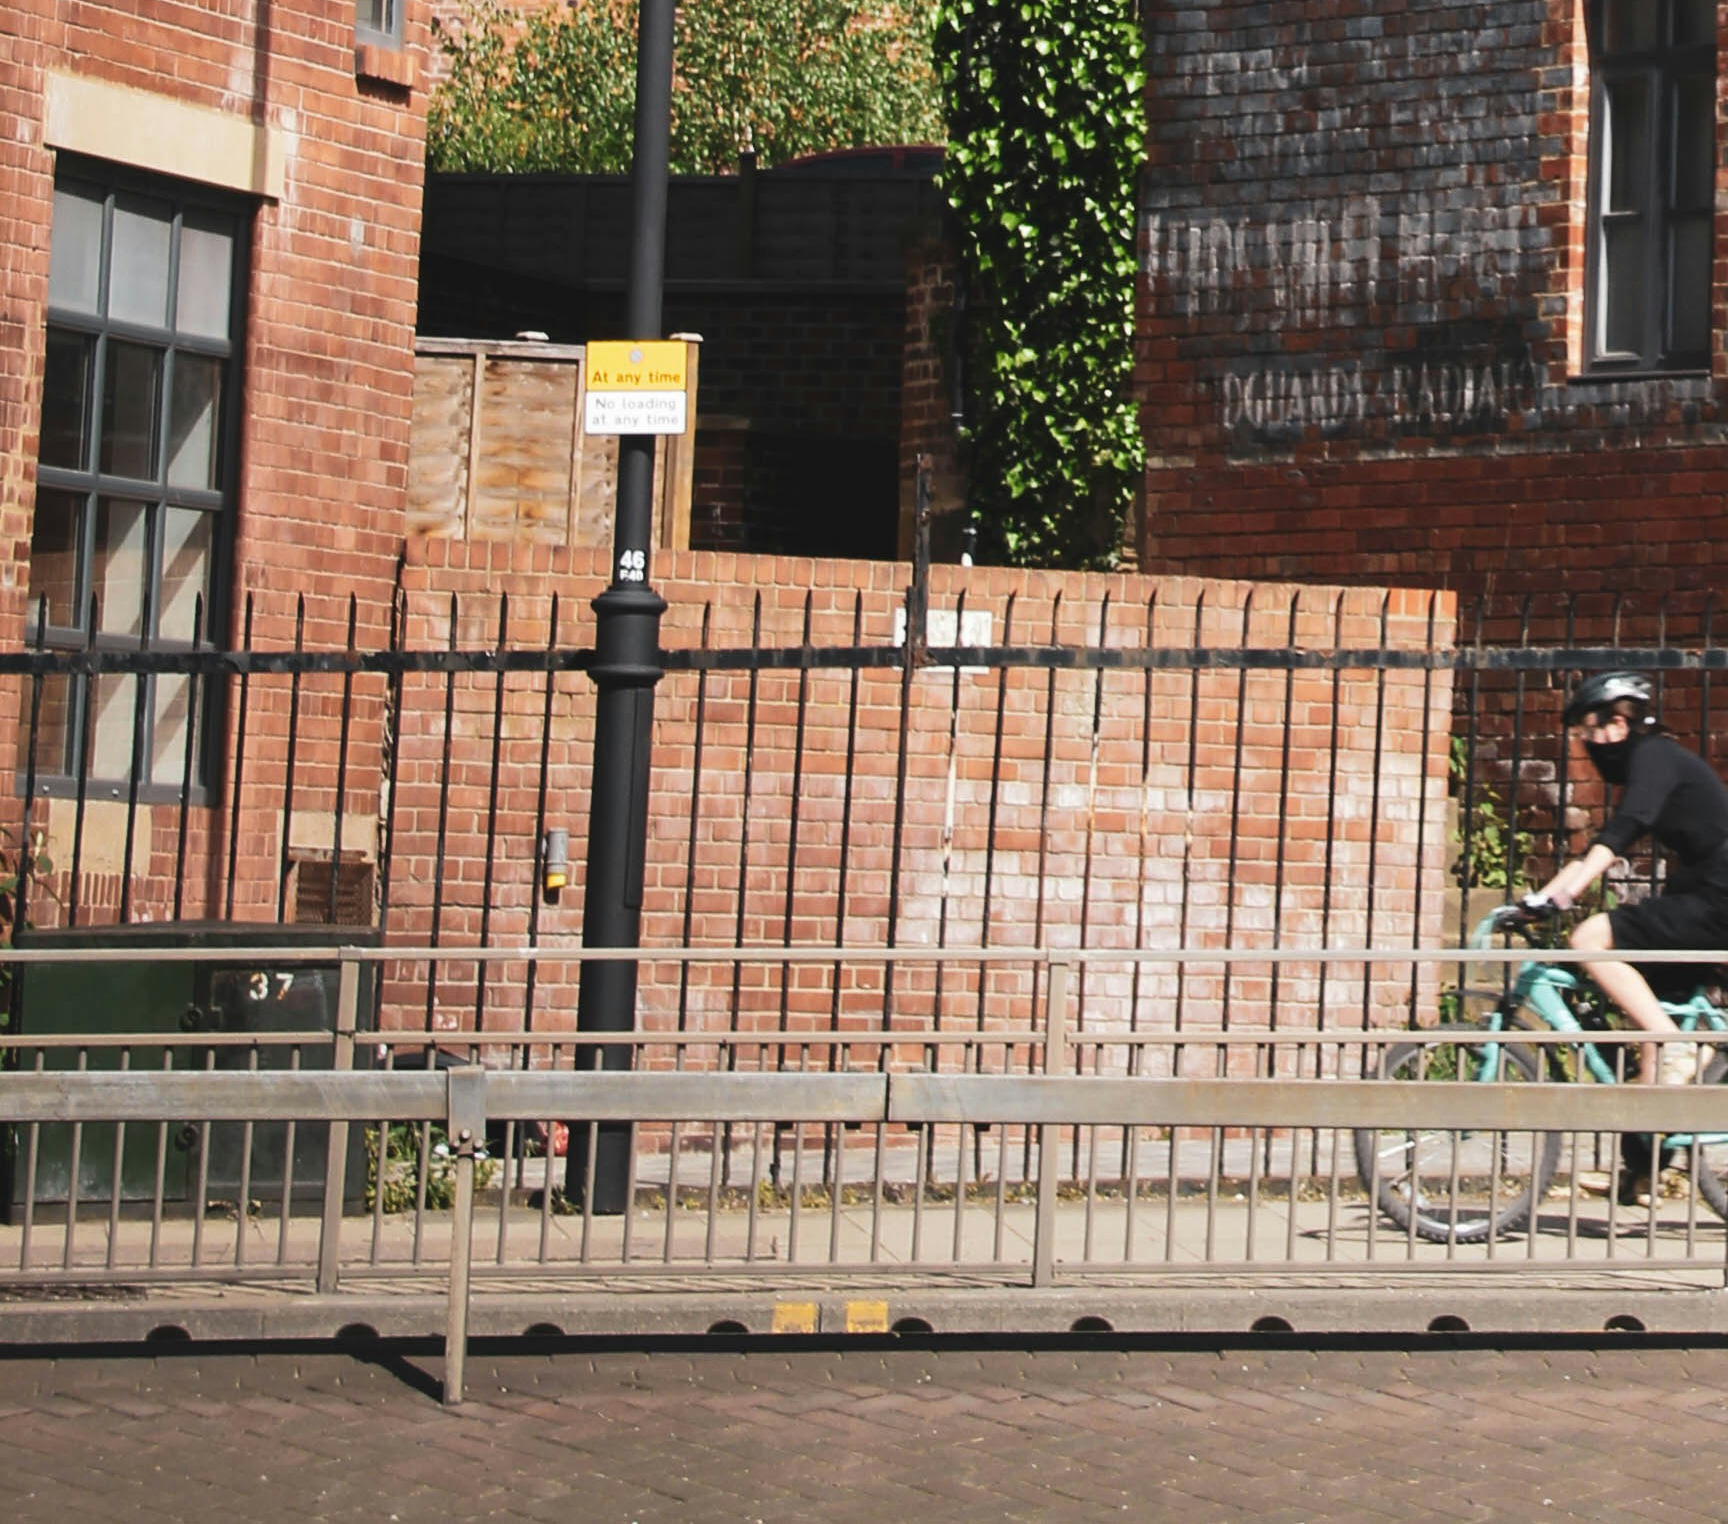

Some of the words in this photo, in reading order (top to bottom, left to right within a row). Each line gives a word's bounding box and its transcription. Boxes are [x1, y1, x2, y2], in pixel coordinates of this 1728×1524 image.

[592, 371, 608, 383] At
[616, 373, 641, 385] any
[648, 370, 681, 383] time
[595, 398, 615, 410] No
[622, 398, 676, 411] loading
[592, 414, 606, 426] at
[615, 416, 639, 428] any
[647, 414, 679, 426] time
[620, 549, 645, 569] 46
[250, 972, 294, 1000] 37
